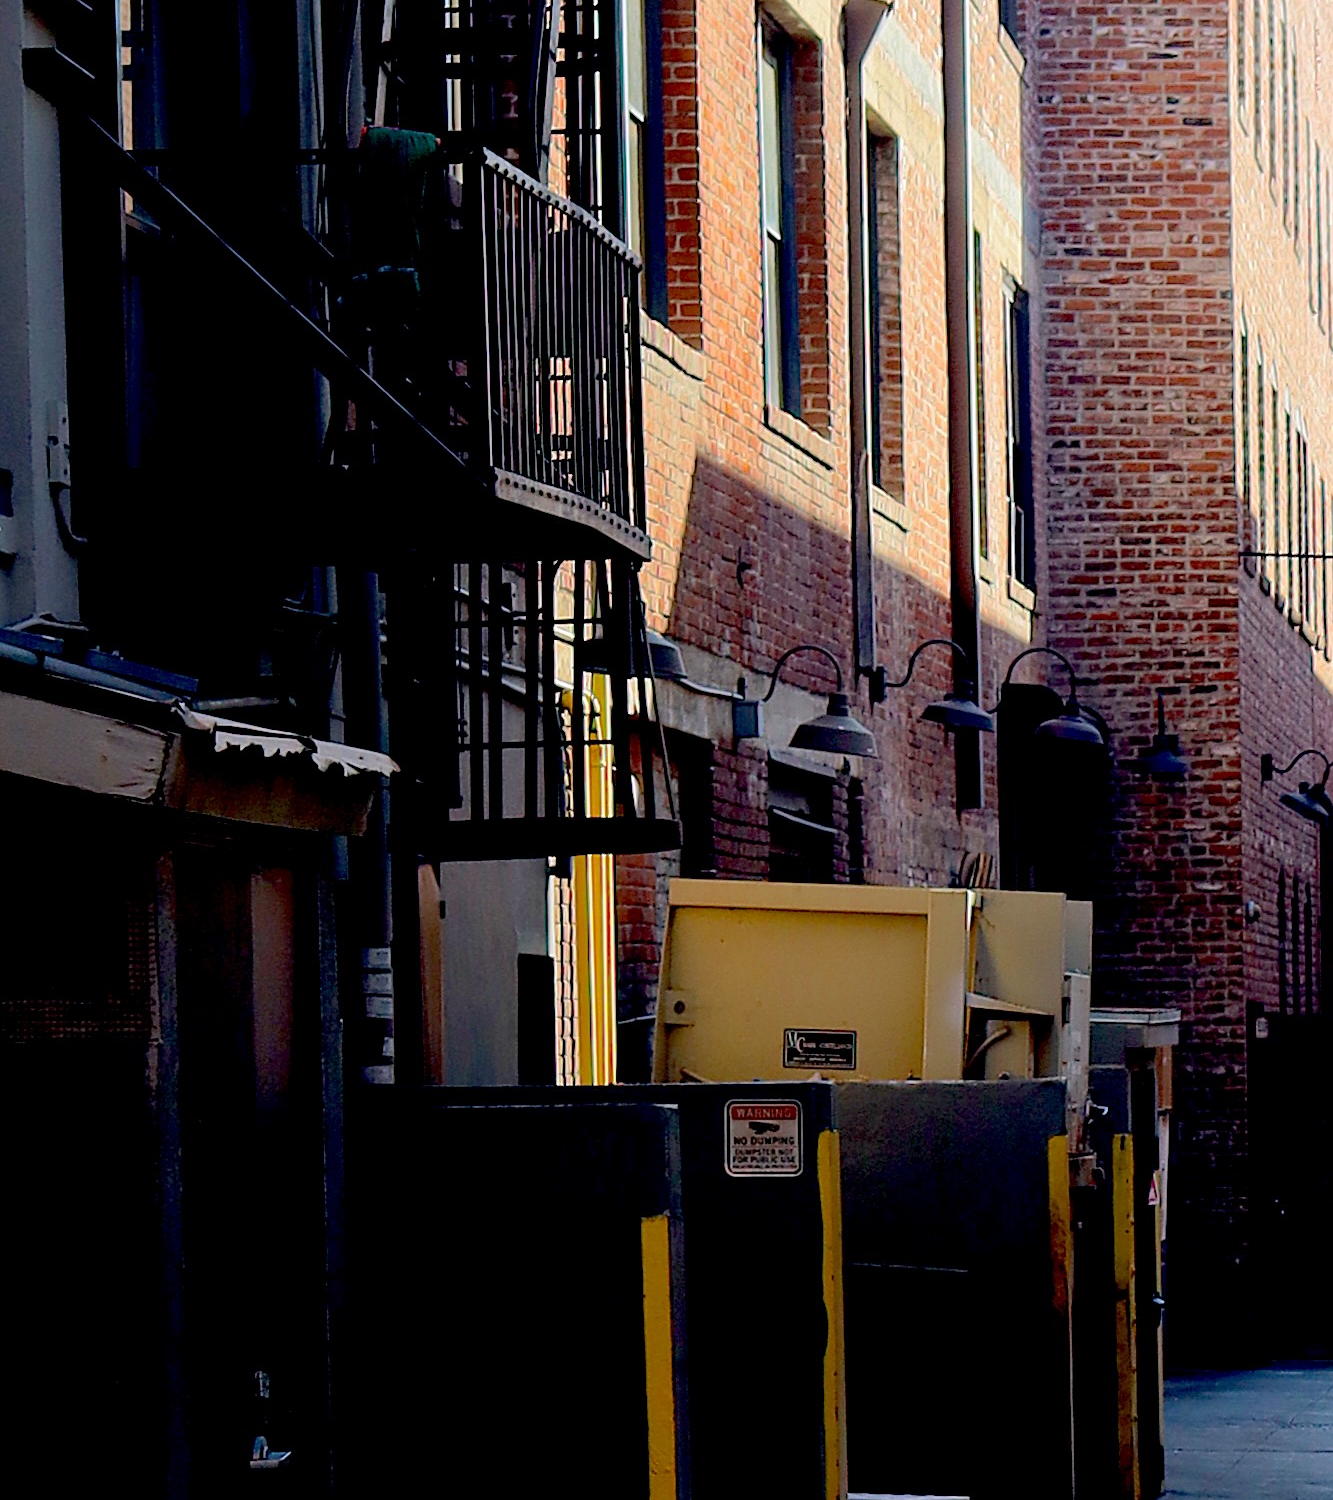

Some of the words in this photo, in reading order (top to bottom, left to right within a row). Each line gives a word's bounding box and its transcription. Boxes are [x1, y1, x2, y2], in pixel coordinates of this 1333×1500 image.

[736, 1107, 791, 1118] WARNING
[733, 1136, 748, 1145] NO
[750, 1136, 795, 1145] DUMPING
